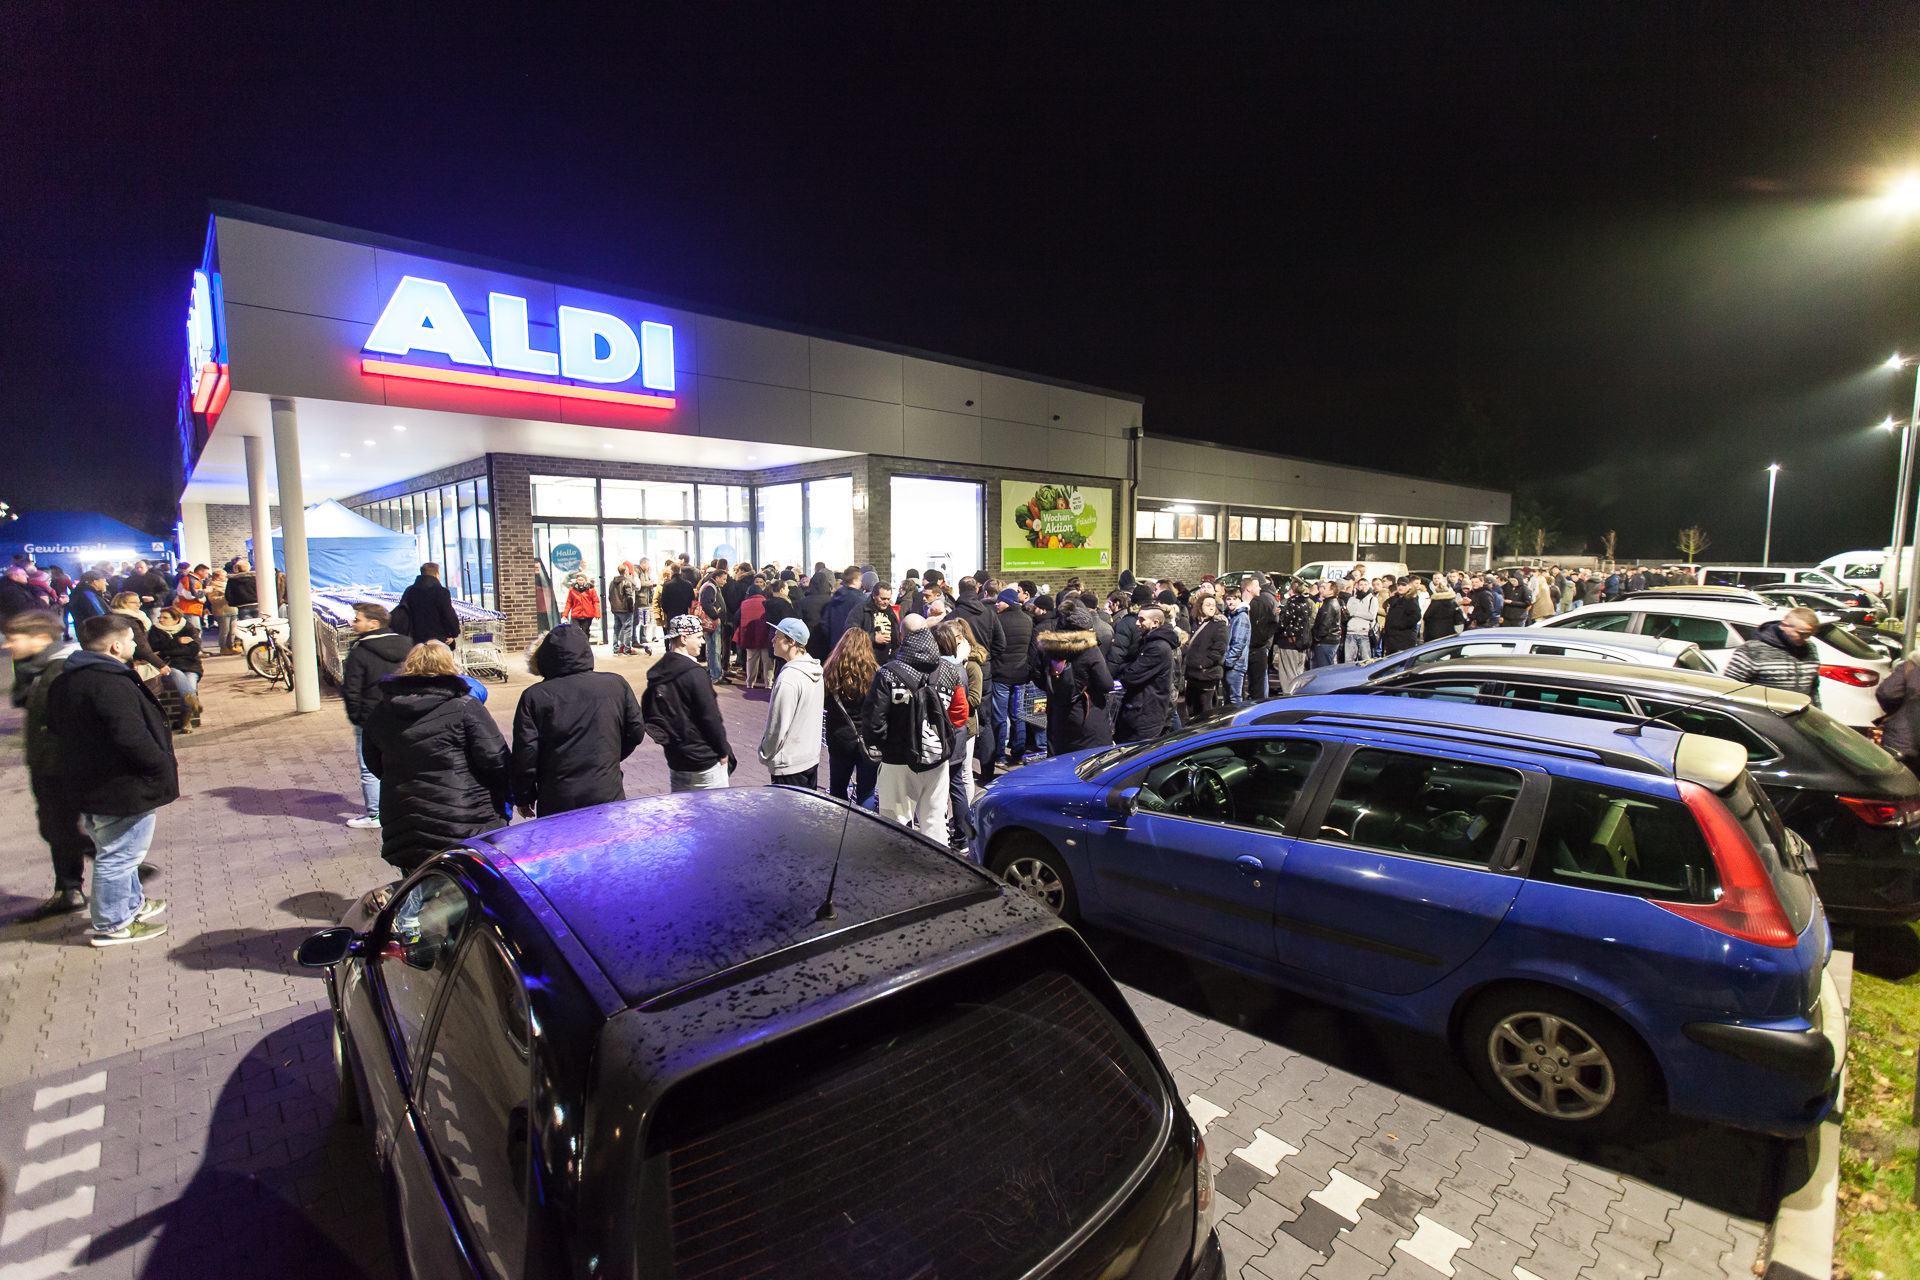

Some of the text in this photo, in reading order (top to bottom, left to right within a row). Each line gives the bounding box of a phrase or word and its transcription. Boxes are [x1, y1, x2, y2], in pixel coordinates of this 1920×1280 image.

[363, 275, 676, 392] ALDI
[1043, 513, 1075, 522] Wochen-
[1076, 516, 1097, 526] Frische
[1045, 522, 1074, 534] Aktion
[24, 542, 107, 554] Gewinnzelt
[556, 549, 577, 557] Hallo
